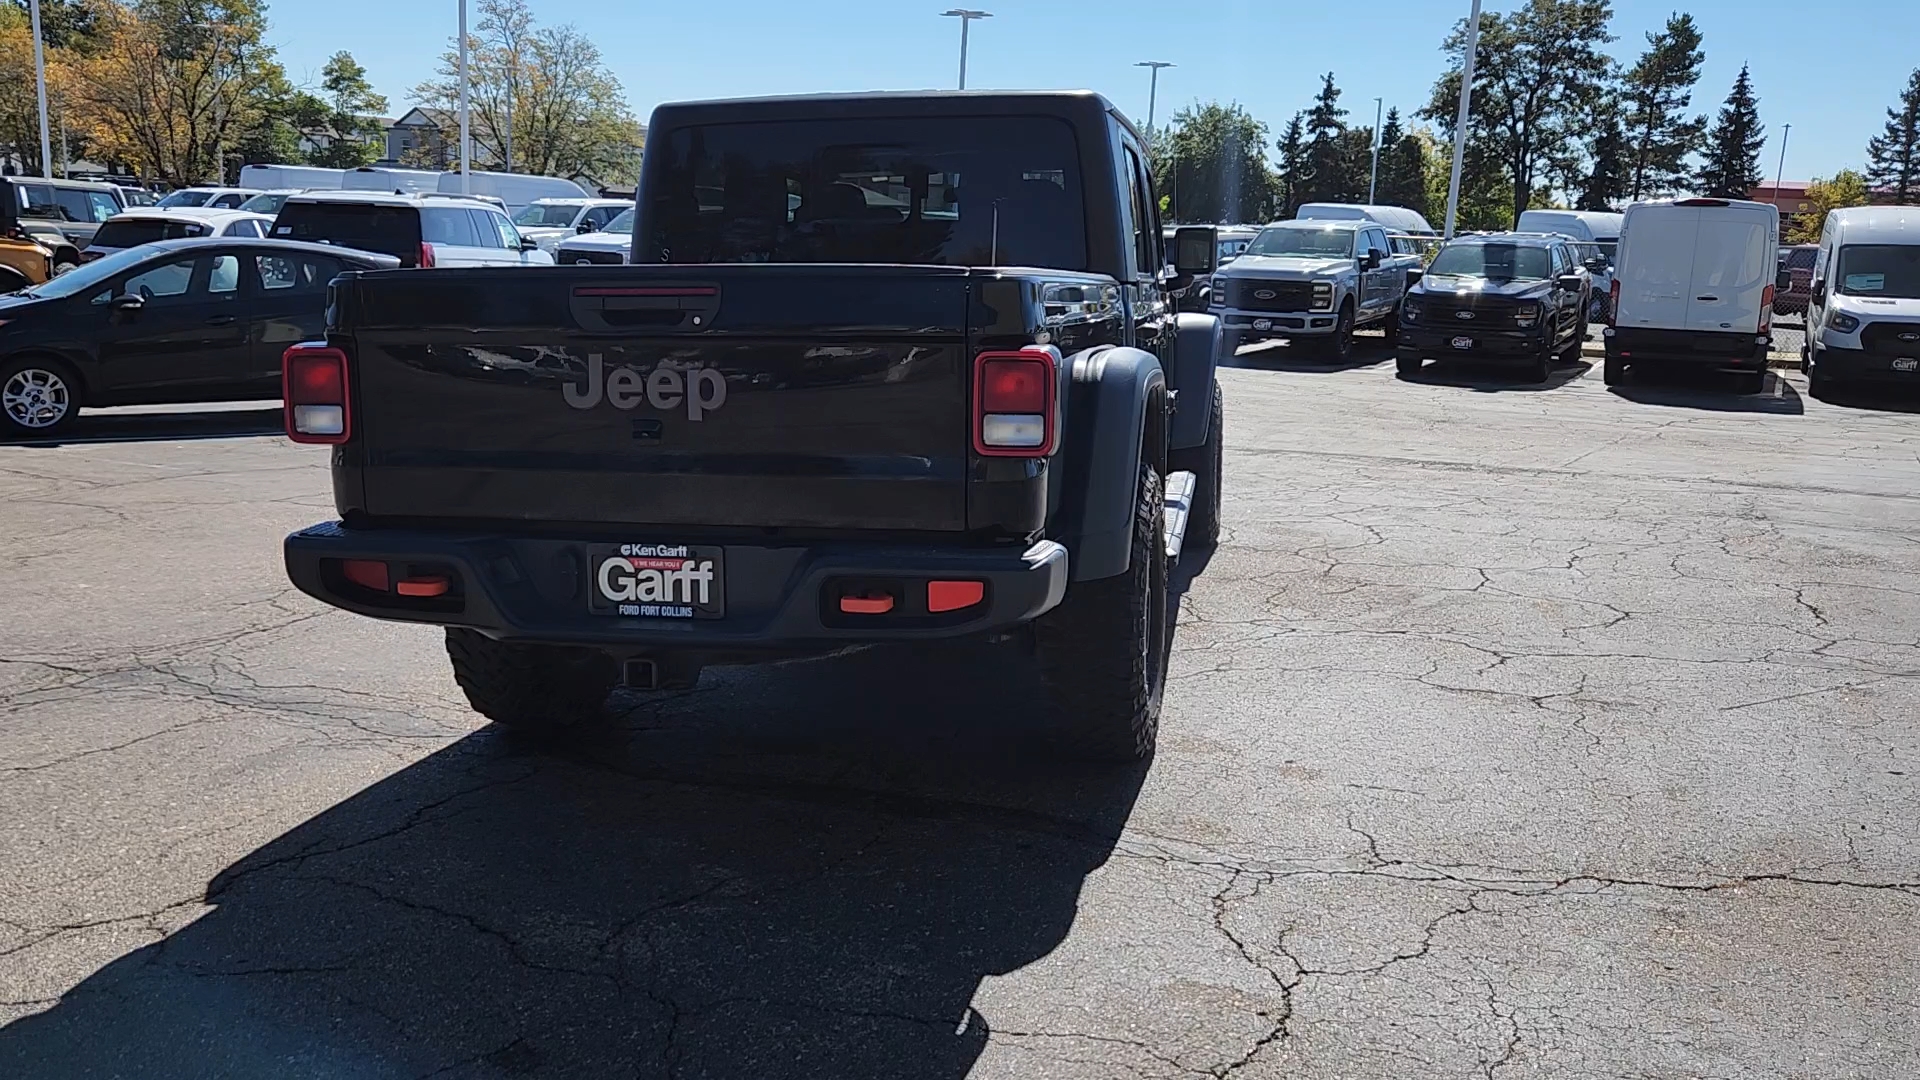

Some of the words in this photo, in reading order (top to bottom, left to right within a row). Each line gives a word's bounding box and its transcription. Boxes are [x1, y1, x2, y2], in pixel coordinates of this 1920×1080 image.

[1892, 359, 1918, 369] Garff
[562, 353, 727, 422] Jeep
[632, 544, 656, 556] Ken
[657, 545, 687, 557] Garff
[598, 557, 713, 604] Garff
[619, 605, 639, 616] FORD
[641, 605, 659, 616] FORT
[662, 606, 693, 617] COLLINS
